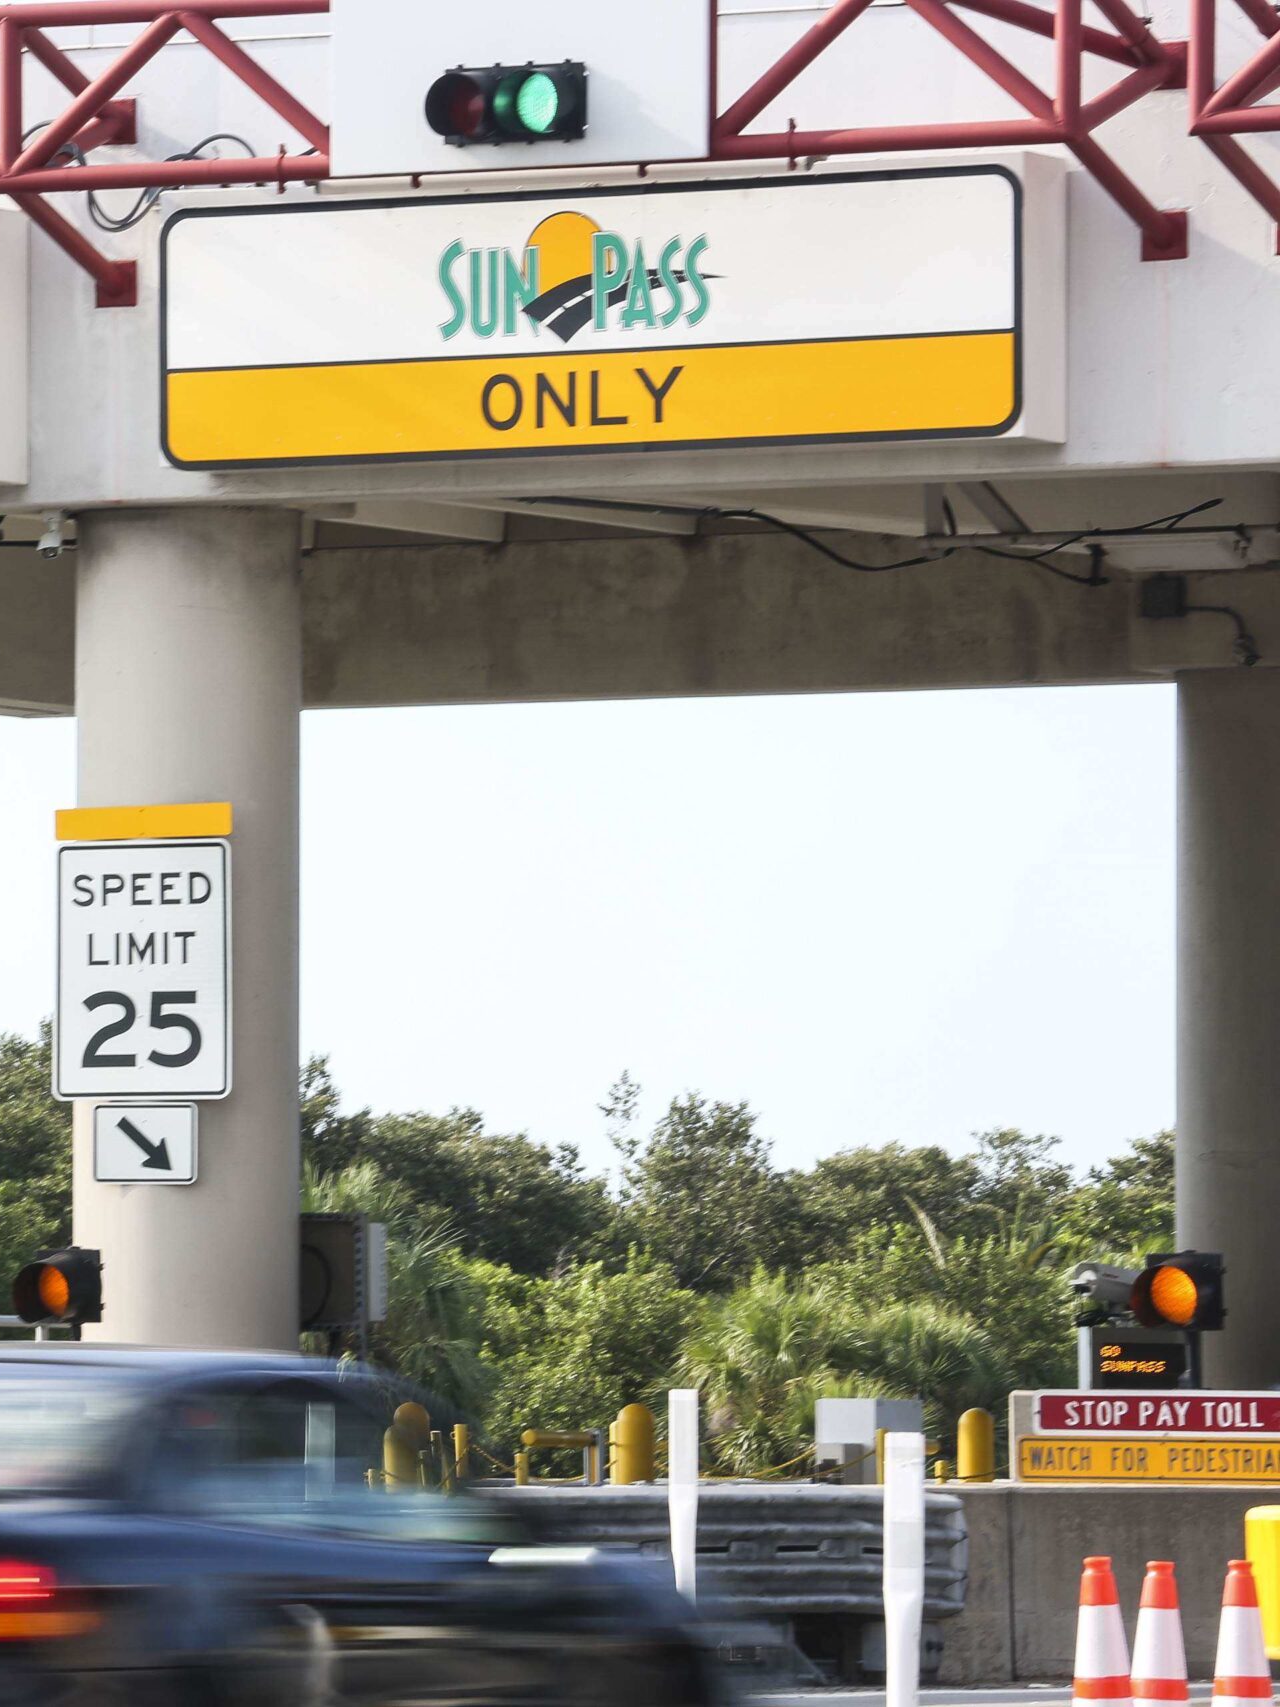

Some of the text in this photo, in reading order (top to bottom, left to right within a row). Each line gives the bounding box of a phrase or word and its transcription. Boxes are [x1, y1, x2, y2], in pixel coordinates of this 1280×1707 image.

[481, 365, 685, 431] ONLY
[72, 871, 212, 907] SPEED
[87, 930, 197, 966] LIMIT
[81, 990, 202, 1069] 25
[1063, 1400, 1265, 1428] STOP PAY TOLL
[1028, 1446, 1280, 1475] WATCH FOR PEDESTRIA
